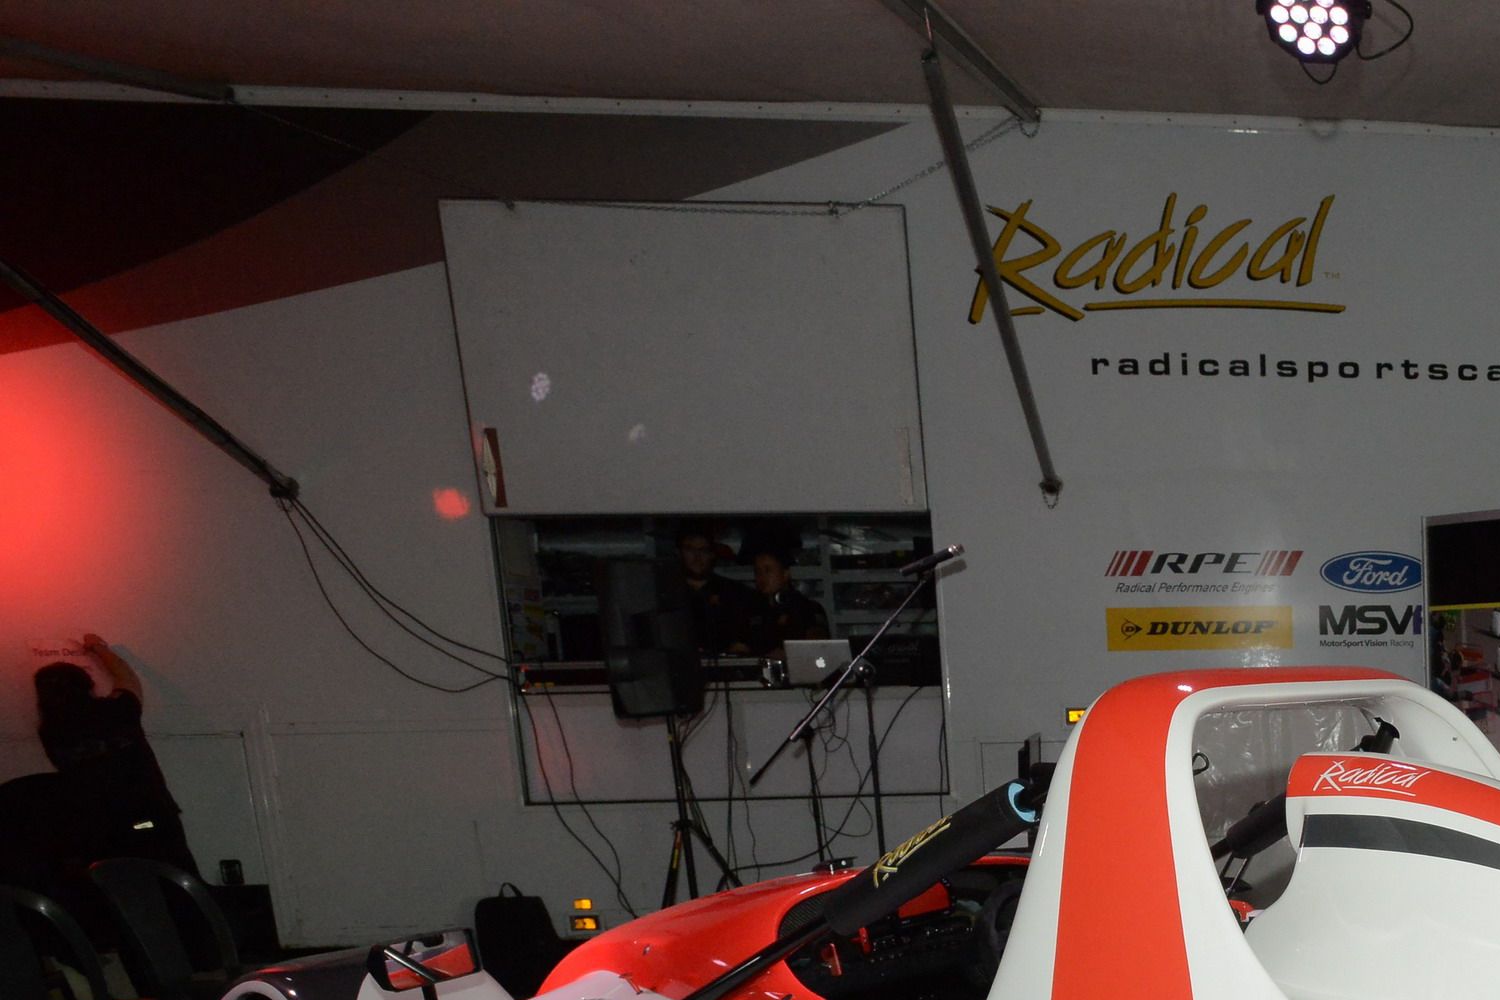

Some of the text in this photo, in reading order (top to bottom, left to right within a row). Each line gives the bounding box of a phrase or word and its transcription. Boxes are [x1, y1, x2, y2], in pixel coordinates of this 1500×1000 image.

[968, 191, 1336, 325] Radical
[1149, 552, 1261, 574] RPE
[1342, 557, 1409, 586] Ford
[1115, 582, 1156, 594] Radical
[1158, 582, 1230, 594] Performance
[1146, 619, 1277, 636] DUNLOP
[1319, 639, 1363, 648] MotorSport
[1364, 639, 1388, 647] Vision
[1312, 760, 1431, 795] Radical
